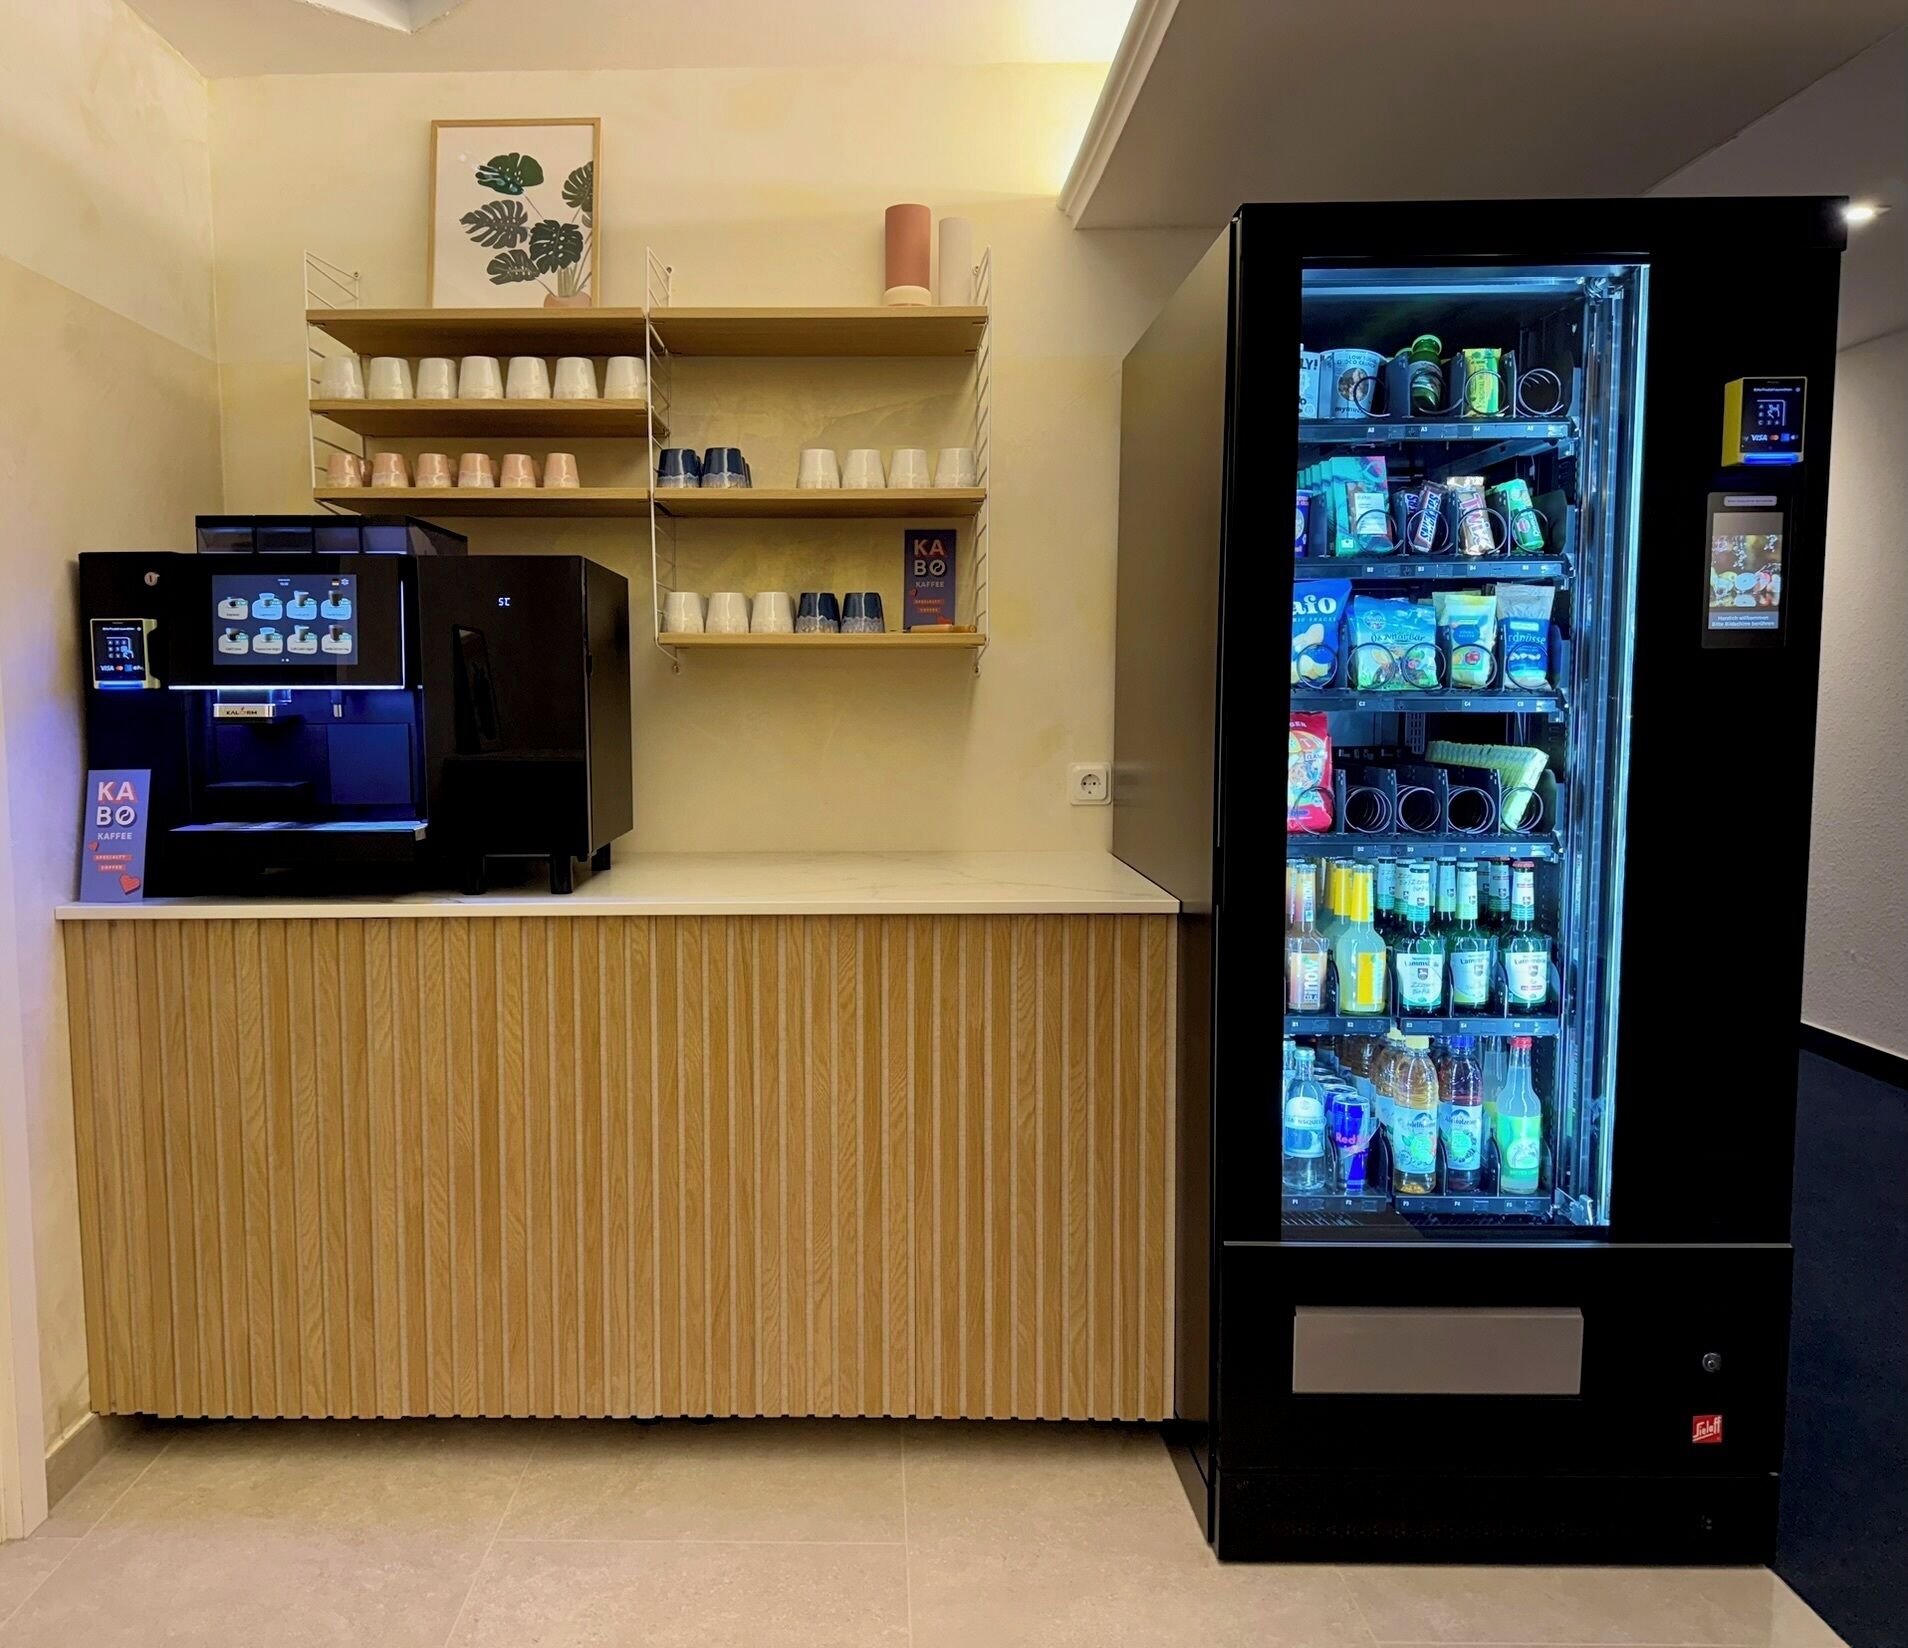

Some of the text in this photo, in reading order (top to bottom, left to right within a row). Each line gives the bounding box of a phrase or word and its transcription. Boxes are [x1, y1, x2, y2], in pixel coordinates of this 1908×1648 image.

[1420, 493, 1441, 542] SNICKERS
[914, 539, 945, 556] KA
[914, 560, 946, 575] BO
[1507, 631, 1546, 644] rdnüsse
[98, 782, 135, 801] KA
[96, 806, 136, 826] BO
[97, 832, 133, 840] KAFFEE
[1335, 1132, 1357, 1144] Red
